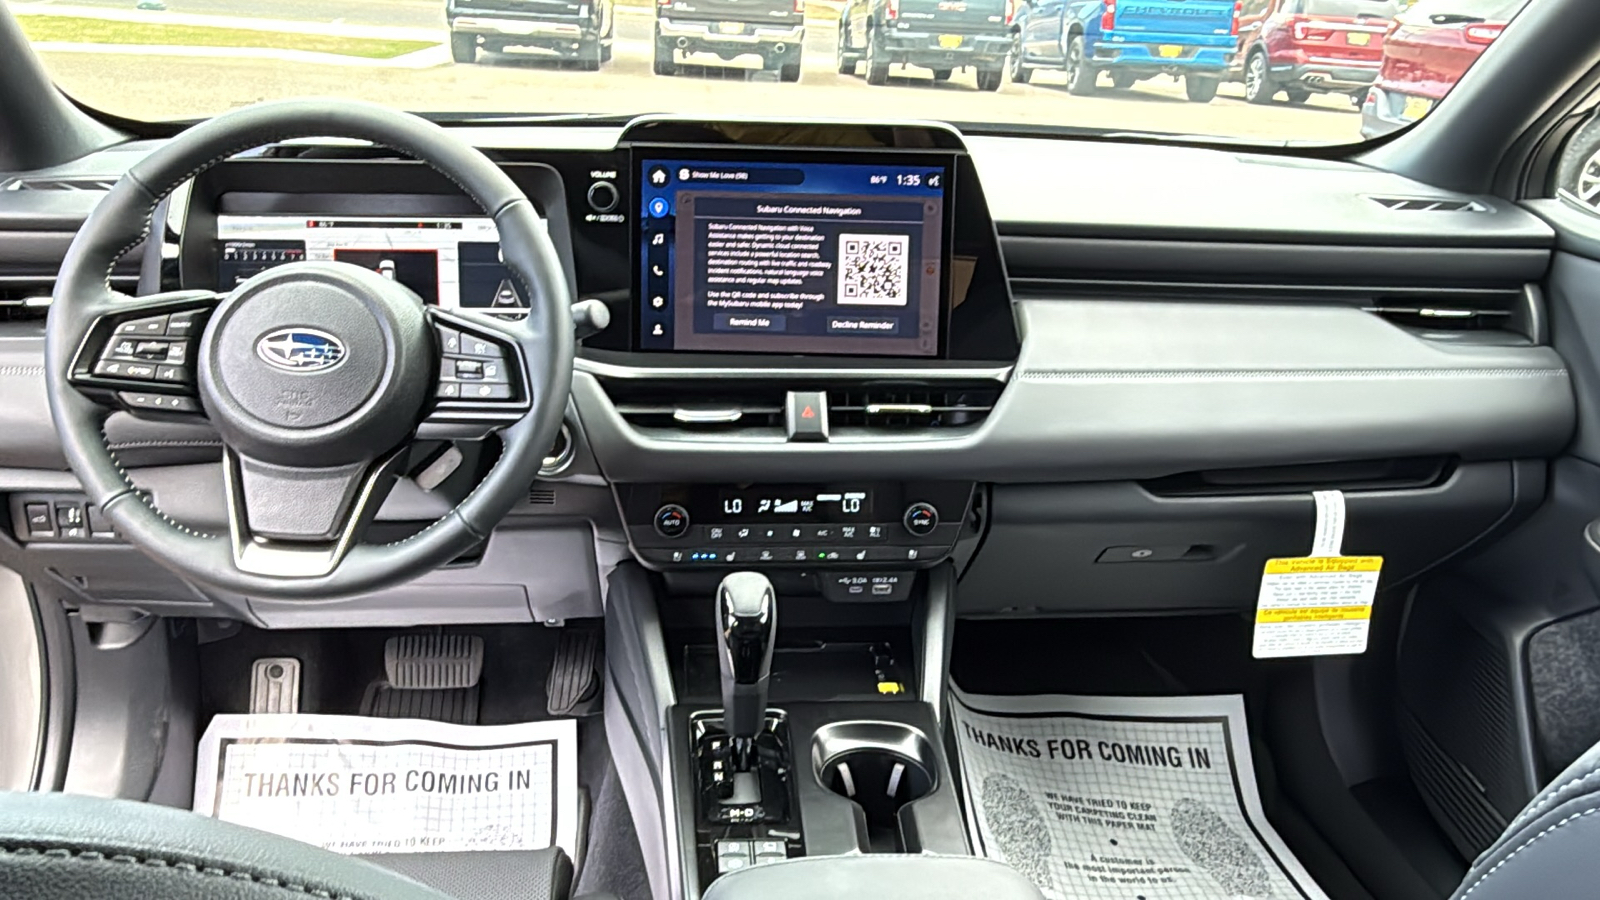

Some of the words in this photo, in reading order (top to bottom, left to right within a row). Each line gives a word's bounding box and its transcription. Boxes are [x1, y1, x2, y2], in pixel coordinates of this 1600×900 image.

[1123, 5, 1227, 16] CHEVROLET
[590, 170, 617, 179] VOLUME
[897, 174, 921, 186] 1:35
[756, 205, 783, 213] Subaru
[783, 205, 822, 215] Connected
[822, 206, 862, 217] Navigation
[707, 290, 720, 298] Use
[720, 290, 731, 298] the
[731, 291, 741, 299] QR
[770, 292, 799, 300] subscribe
[799, 293, 825, 302] through
[729, 317, 756, 327] Remind
[757, 318, 771, 327] Me
[831, 320, 858, 329] Decline
[858, 321, 895, 330] Reminder
[724, 498, 743, 514] LO
[842, 498, 860, 513] LO
[663, 518, 681, 527] AUTO
[913, 518, 930, 526] SYNC
[961, 720, 1041, 758] THANKS
[1047, 739, 1093, 760] FOR
[1098, 741, 1182, 769] COMING
[1188, 747, 1212, 770] IN
[244, 772, 340, 797] THANKS
[350, 772, 396, 796] FOR
[405, 769, 499, 795] COMING
[508, 769, 531, 790] IN
[1045, 791, 1058, 800] WE
[1060, 794, 1084, 805] HAVE
[1086, 797, 1114, 808] TRIED
[1116, 800, 1128, 810] TO
[1129, 802, 1152, 812] KEEP
[1048, 801, 1073, 812] YOUR
[1074, 805, 1126, 820] CARPETING
[1127, 812, 1158, 822] CLEAN
[1056, 812, 1080, 823] WITH
[1082, 816, 1103, 827] THIS
[1105, 819, 1135, 829] PAPER
[1136, 823, 1156, 832] MAT
[340, 840, 368, 848] HAVE
[405, 837, 416, 847] TO
[420, 836, 446, 846] KEEP
[1091, 853, 1098, 862] A
[1099, 856, 1143, 866] customer
[1145, 857, 1156, 865] is
[1064, 861, 1080, 870] the
[1082, 864, 1107, 873] most
[1108, 866, 1156, 876] important
[1157, 867, 1192, 876] person
[1087, 874, 1098, 882] in
[1100, 875, 1117, 884] the
[1118, 876, 1147, 884] world
[1147, 876, 1159, 884] to
